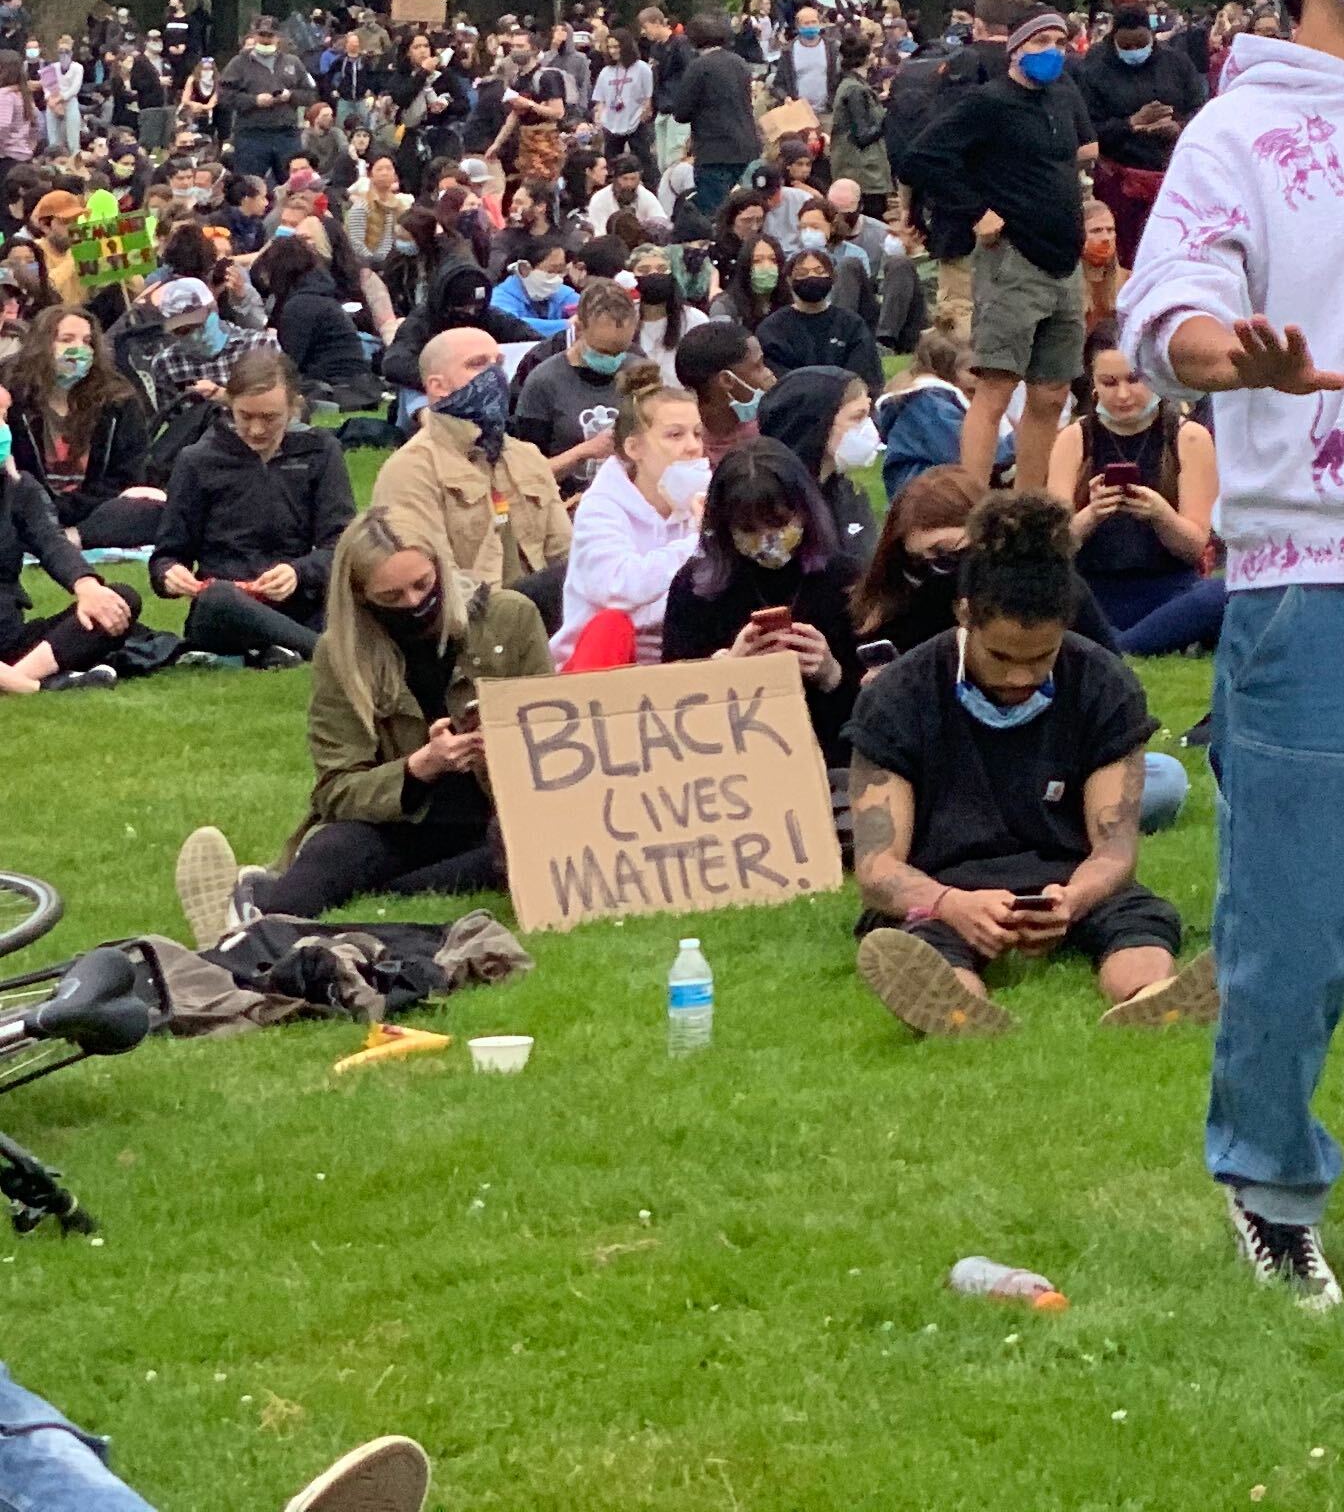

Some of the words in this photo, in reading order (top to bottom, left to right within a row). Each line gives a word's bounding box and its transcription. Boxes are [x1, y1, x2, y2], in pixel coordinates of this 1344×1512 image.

[517, 686, 792, 791] BLACK
[604, 774, 752, 841] LIVES
[549, 809, 811, 917] MATTER!
